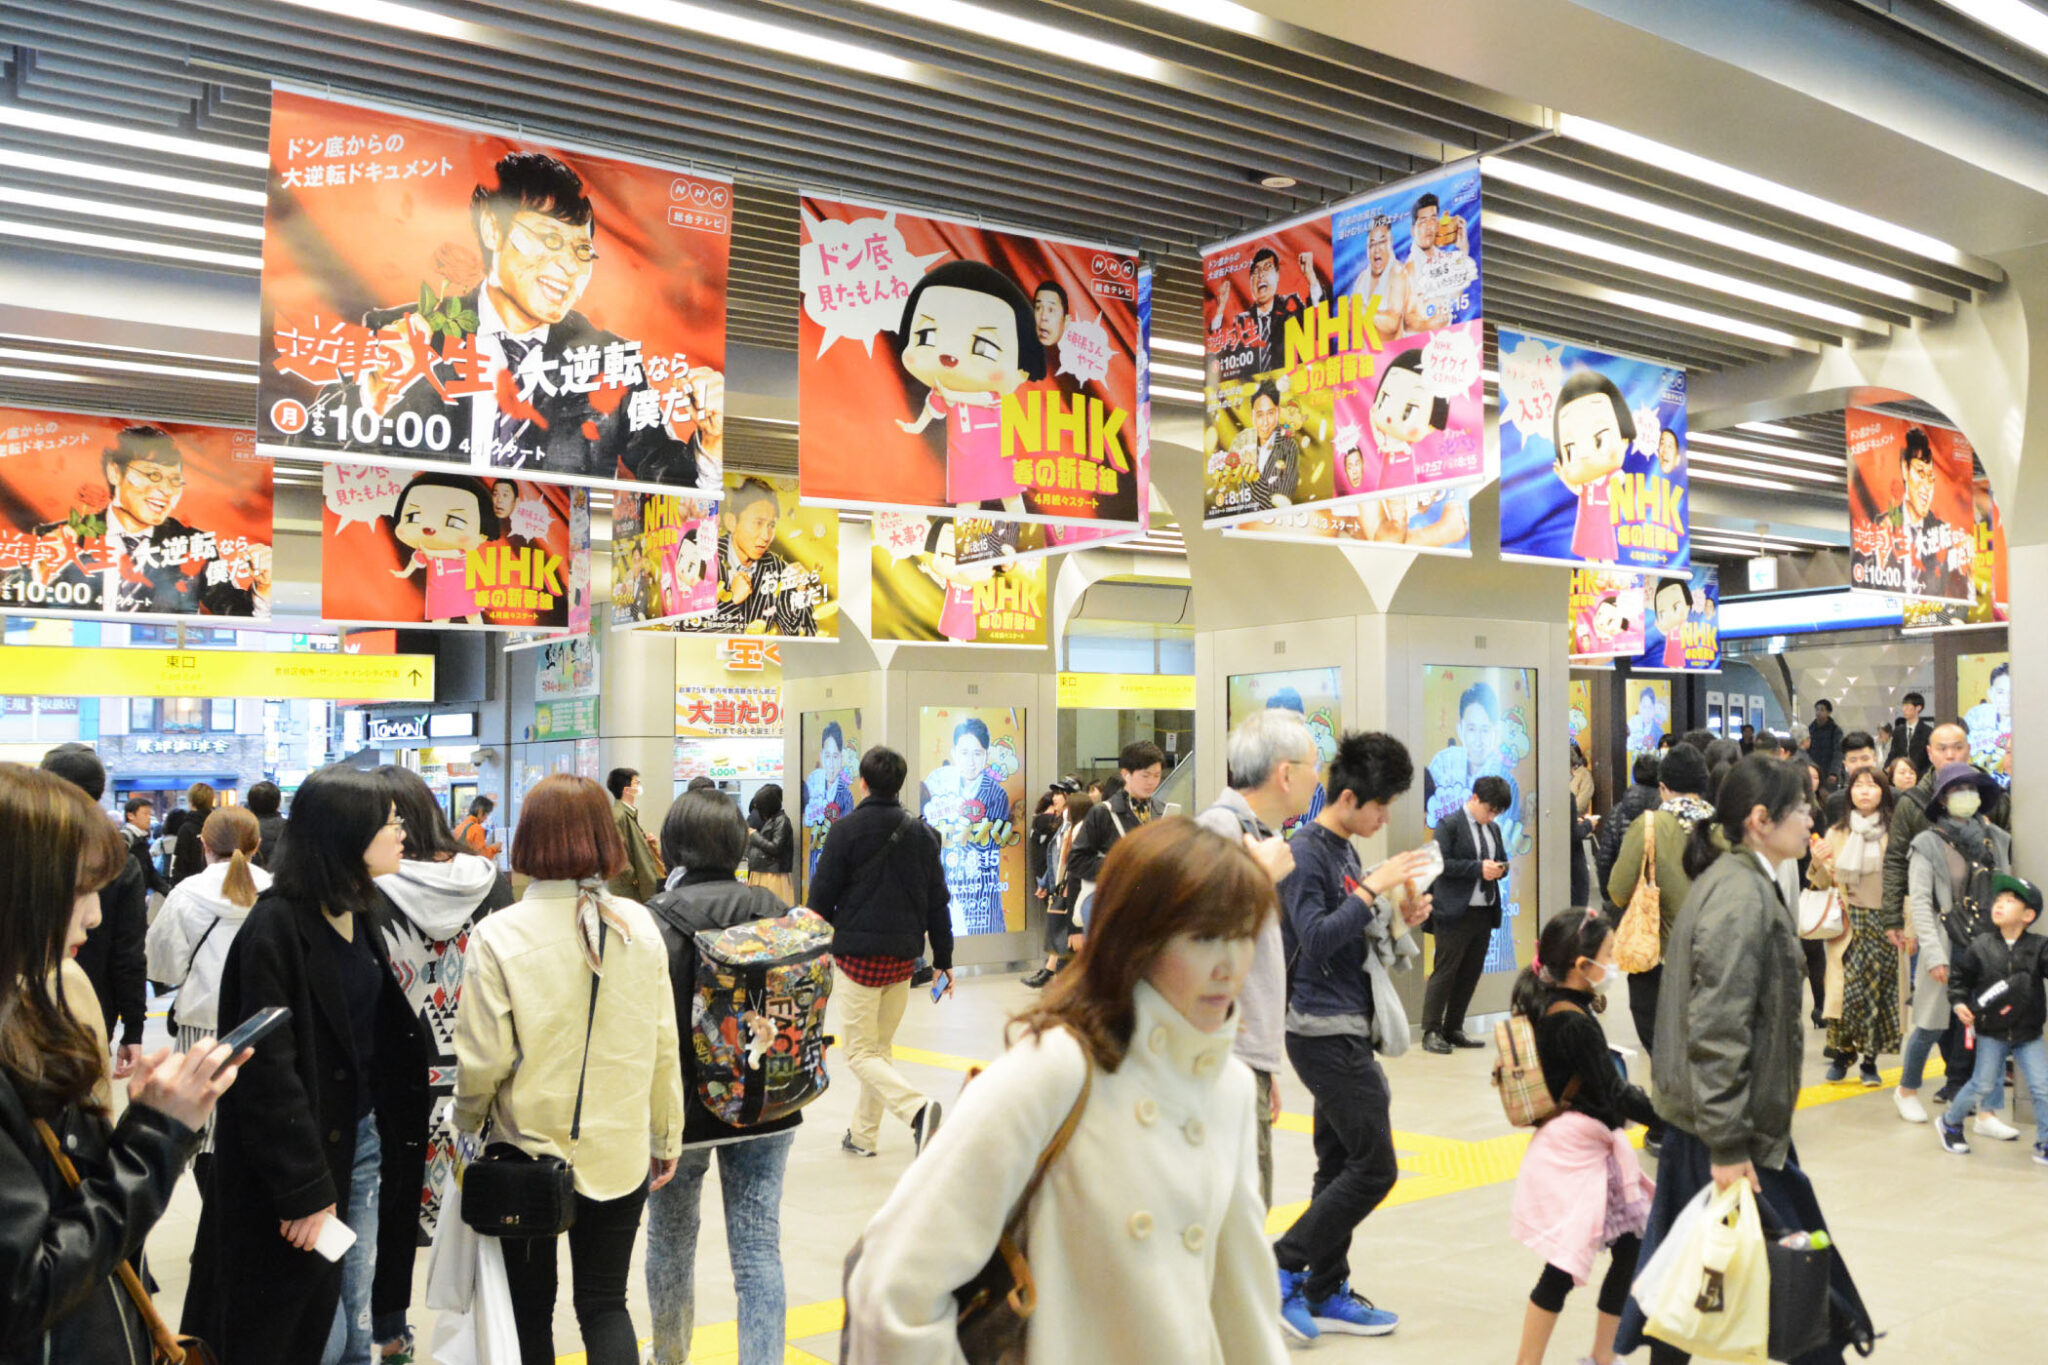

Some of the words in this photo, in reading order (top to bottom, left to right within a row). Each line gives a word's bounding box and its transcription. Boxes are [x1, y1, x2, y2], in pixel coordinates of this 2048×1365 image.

[287, 133, 404, 160] ドン底からの
[281, 156, 453, 189] 大逆転ドキュメント
[673, 182, 726, 207] NHK
[673, 211, 722, 229] 総合テレビ
[819, 232, 894, 276] ドン底
[1094, 256, 1133, 277] NHK
[818, 276, 909, 312] 見たもんね
[1284, 293, 1384, 374] NHK
[516, 340, 643, 402] 大逆転
[647, 352, 689, 382] なら
[1223, 351, 1254, 371] 10:00
[280, 406, 298, 427] 月
[311, 404, 326, 437] よる
[329, 405, 451, 451] 10:00
[1000, 390, 1130, 473] NHK
[1012, 456, 1119, 494] 春の新番組
[335, 480, 401, 507] 見たもんね
[1034, 492, 1099, 510] 4月続々スタート
[1608, 473, 1685, 537] NHK
[644, 495, 682, 532] NHK
[1331, 519, 1361, 532] スタート
[133, 531, 217, 573] 大逆転
[220, 536, 249, 555] なら
[464, 546, 563, 596] NHK
[1869, 565, 1901, 587] 10:00
[13, 581, 91, 604] 10:00
[474, 587, 554, 611] 春の新番組
[972, 576, 1043, 619] NHK
[1680, 621, 1719, 652] NHK
[165, 655, 196, 669] 東口
[368, 714, 429, 739] TOMONY
[687, 700, 784, 725] 大当たり
[766, 999, 795, 1075] FACE
